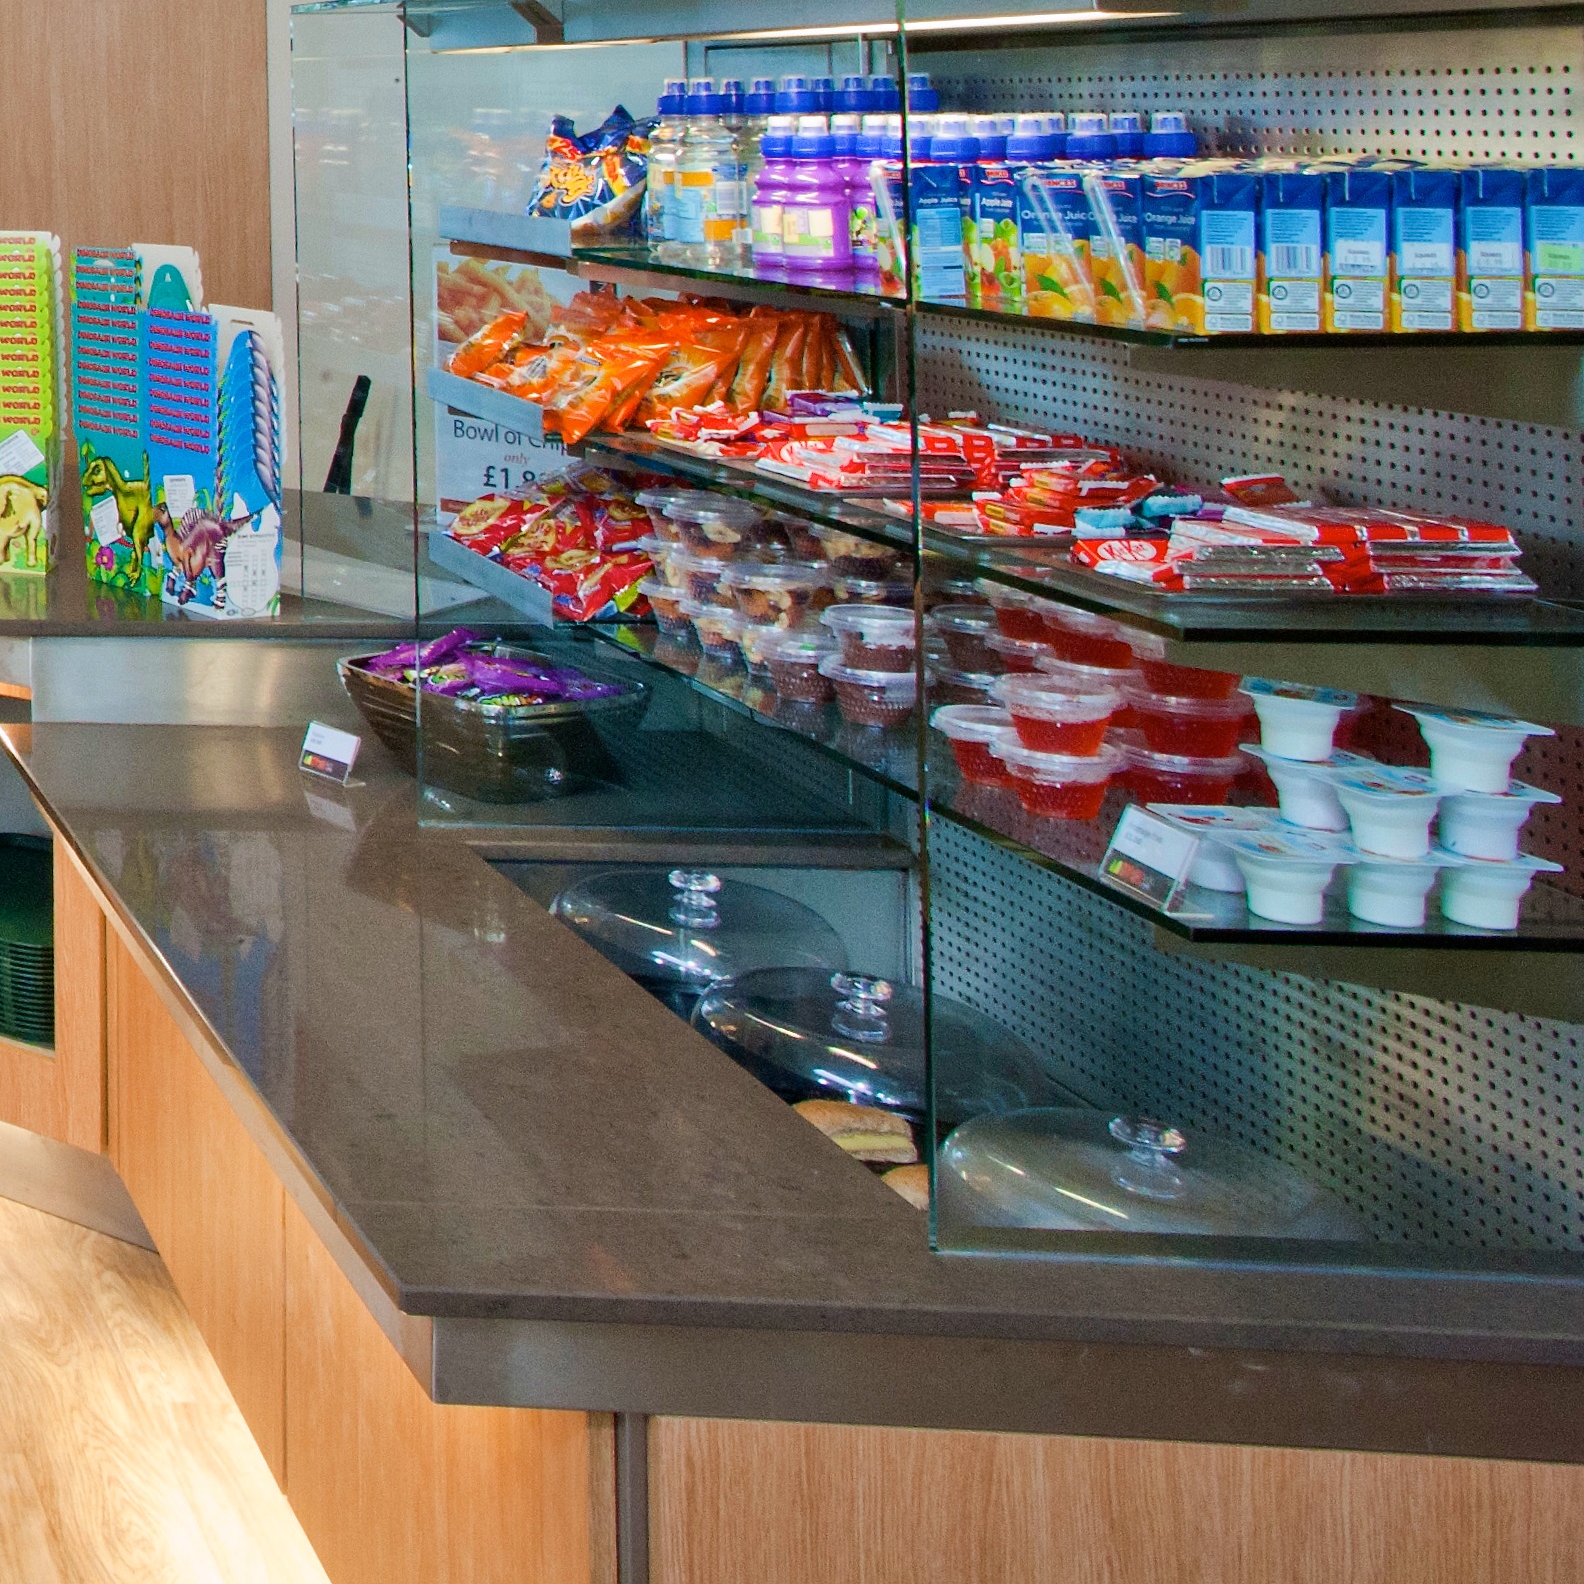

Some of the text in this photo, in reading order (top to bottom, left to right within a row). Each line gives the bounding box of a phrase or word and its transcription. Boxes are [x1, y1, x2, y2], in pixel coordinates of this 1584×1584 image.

[0, 288, 36, 297] WORLD
[0, 304, 36, 312] WORLD
[0, 320, 37, 328] WORLD
[0, 336, 37, 345] WORLD
[1, 354, 38, 362] WORLD
[2, 370, 39, 378] WORLD
[2, 385, 39, 394] WORLD
[3, 401, 40, 410] WORLD
[3, 416, 40, 425] WORLD
[453, 420, 499, 443] Bowl
[503, 452, 529, 467] only
[483, 465, 536, 490] £1.8
